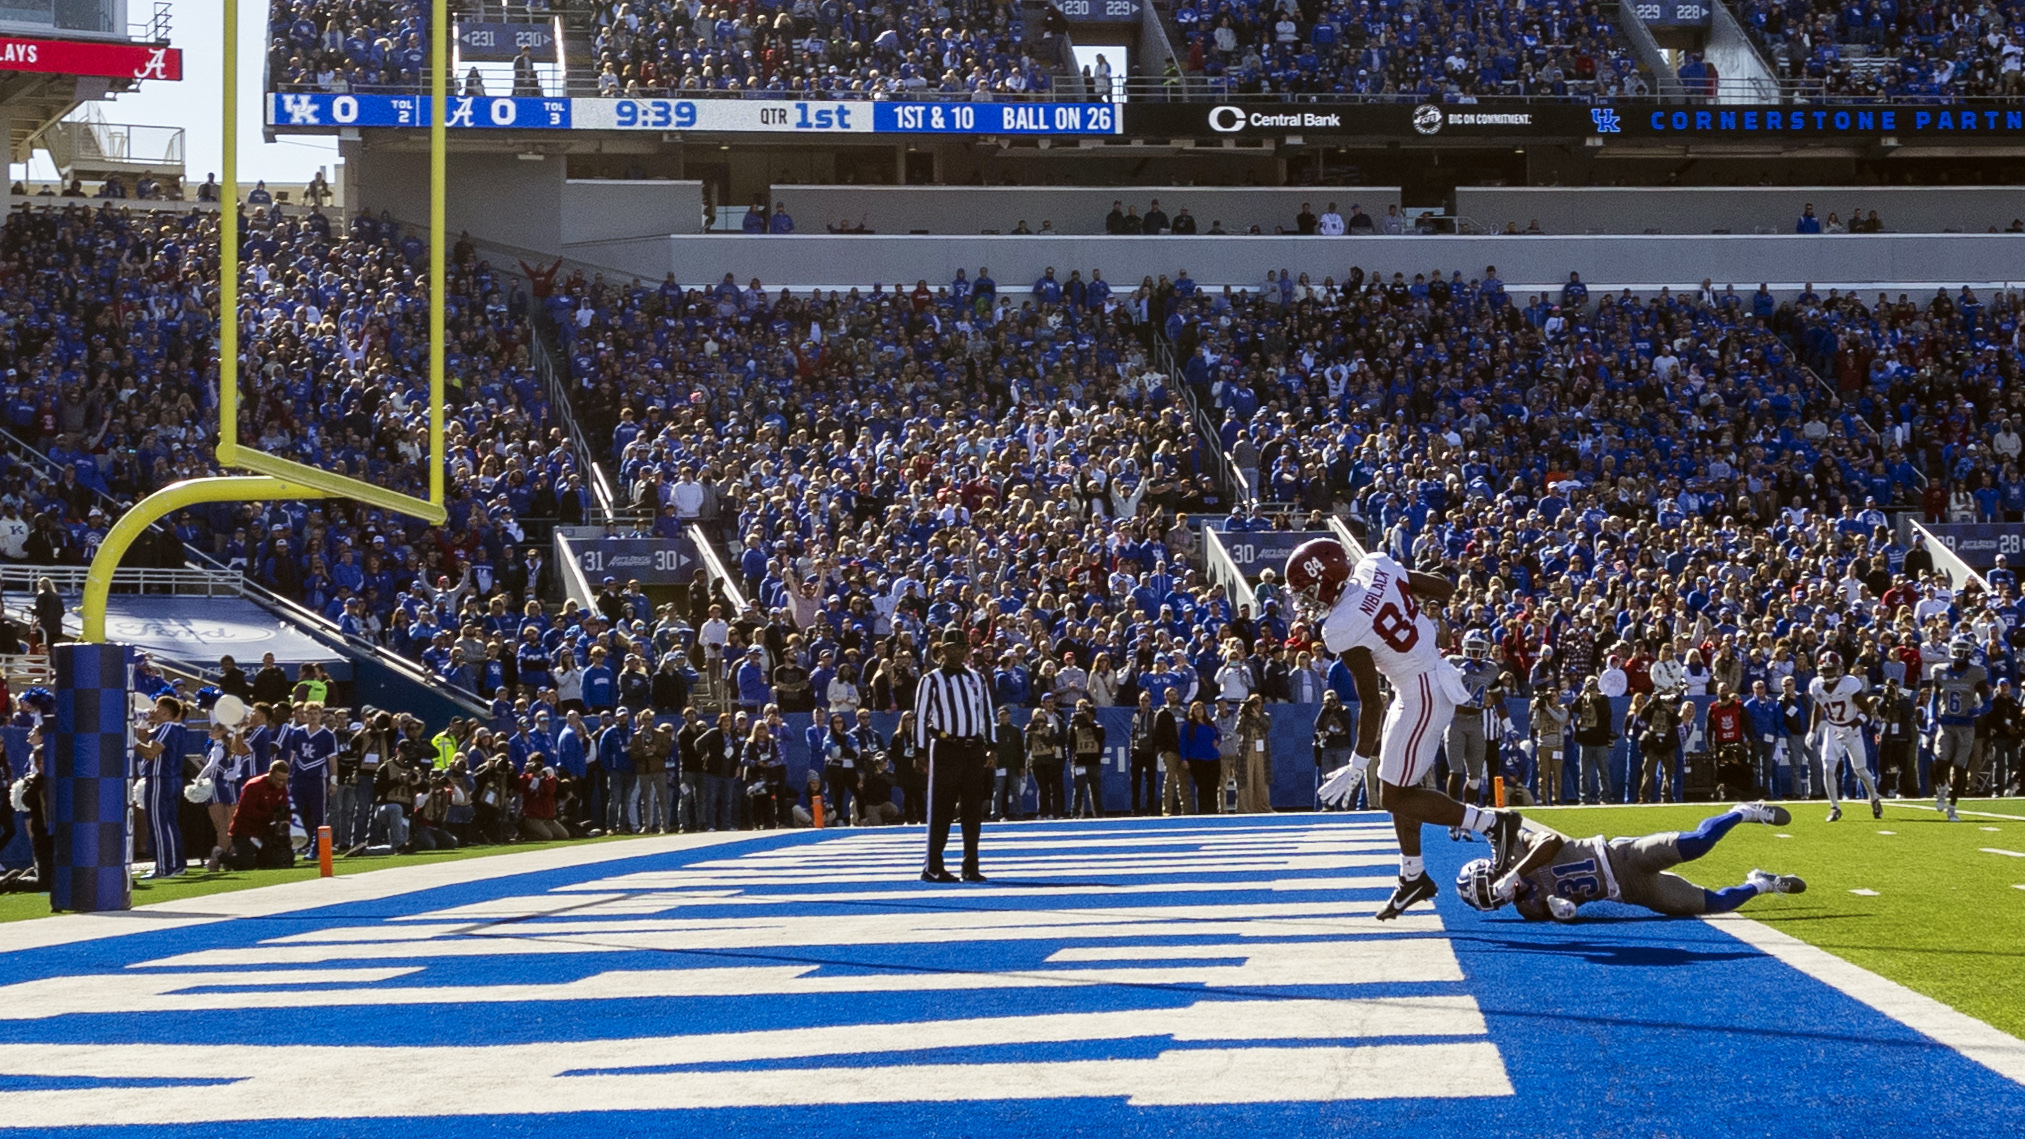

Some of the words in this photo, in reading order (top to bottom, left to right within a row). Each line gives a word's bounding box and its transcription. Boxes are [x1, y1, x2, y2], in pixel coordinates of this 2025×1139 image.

[1064, 1, 1089, 15] 230
[1106, 1, 1130, 15] 229
[1636, 4, 1660, 19] 229
[1676, 5, 1699, 19] 228
[471, 31, 495, 46] 231
[516, 32, 541, 46] 230
[332, 96, 358, 123] 0
[391, 100, 413, 109] TOL
[491, 98, 516, 126] 0
[543, 102, 565, 111] TOL
[398, 110, 410, 122] 2
[550, 113, 561, 125] 3
[616, 101, 697, 128] 9:39
[760, 108, 787, 125] QTR
[795, 103, 851, 129] 1st
[893, 106, 926, 129] 1ST
[930, 106, 945, 129] &
[951, 106, 974, 129] 10
[1003, 107, 1050, 130] BALL
[1055, 107, 1081, 130] ON
[1087, 107, 1112, 130] 26
[1250, 113, 1301, 127] Central
[1304, 114, 1341, 127] Bank
[1448, 114, 1463, 124] BIG
[1464, 114, 1475, 124] ON
[1651, 111, 1896, 130] CORNERSTONE
[1915, 111, 2024, 131] PARTN
[10, 526, 24, 535] K
[1232, 544, 1254, 564] 30
[2000, 535, 2020, 554] 28
[584, 551, 604, 571] 31
[655, 551, 677, 570] 30
[1303, 556, 1326, 578] 84
[1359, 567, 1391, 617] NIBLACK
[1372, 576, 1421, 653] 84
[1823, 700, 1847, 722] 17
[1948, 690, 1962, 715] 6
[1551, 858, 1600, 899] 31
